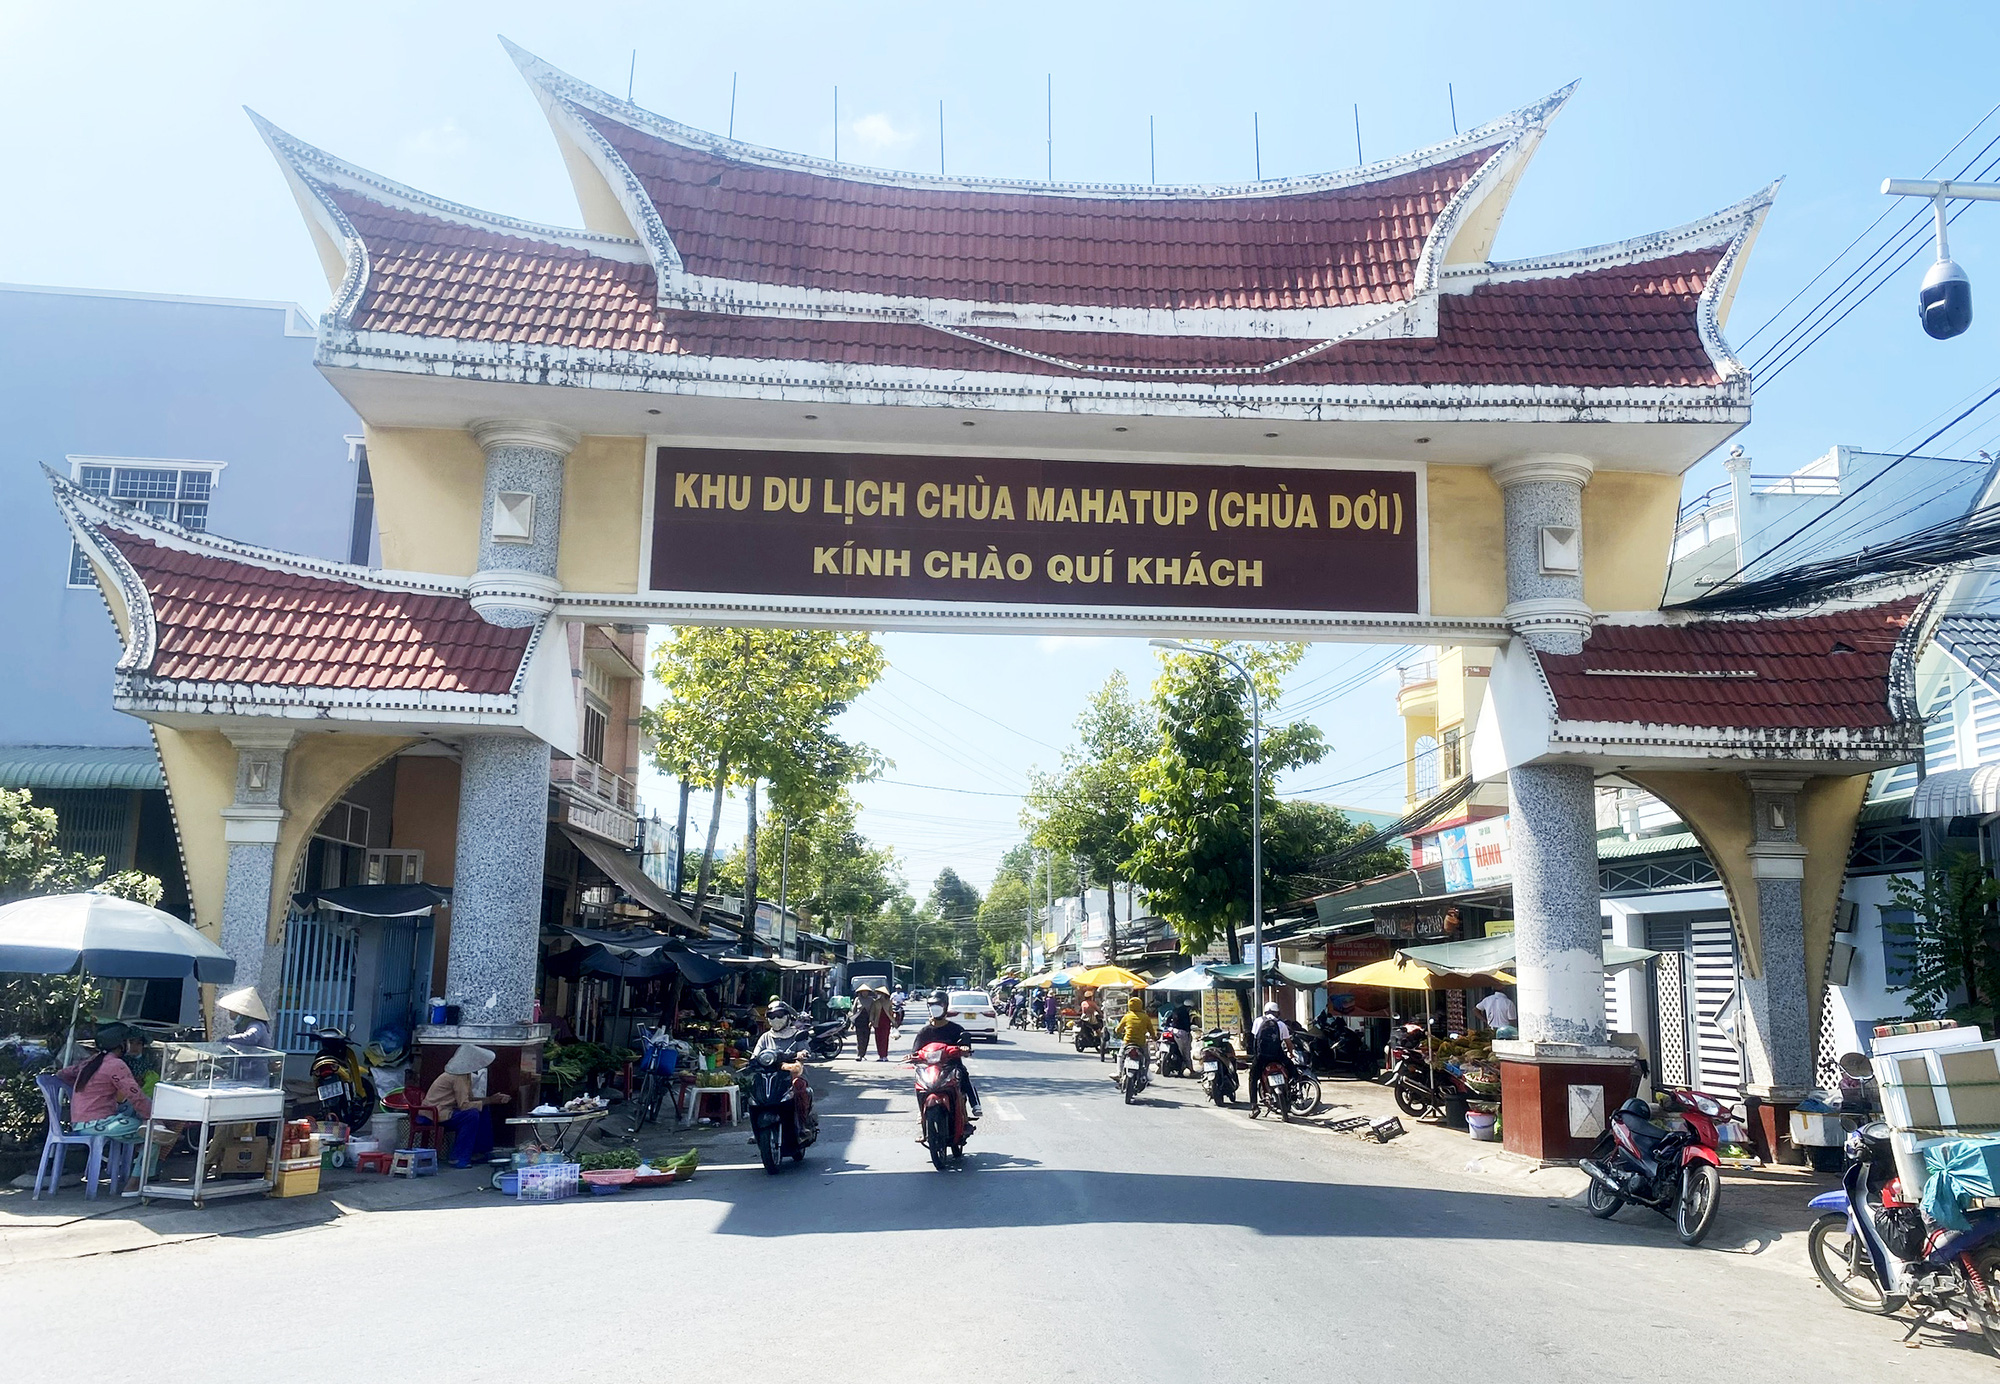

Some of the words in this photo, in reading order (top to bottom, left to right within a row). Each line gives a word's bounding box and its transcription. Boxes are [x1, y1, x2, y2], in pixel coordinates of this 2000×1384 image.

[674, 472, 751, 511] KHU
[763, 476, 811, 513] DU
[823, 478, 905, 525] LỊCH
[916, 475, 1015, 521] CHÙA
[1026, 486, 1198, 526] MAHATUP
[1208, 483, 1318, 531] (CHÙA
[1329, 489, 1403, 535] DƠI)
[813, 540, 911, 577] KÍNH
[923, 545, 1033, 581] CHÀO
[1046, 549, 1115, 584] QUÍ
[1127, 551, 1263, 587] KHÁCH
